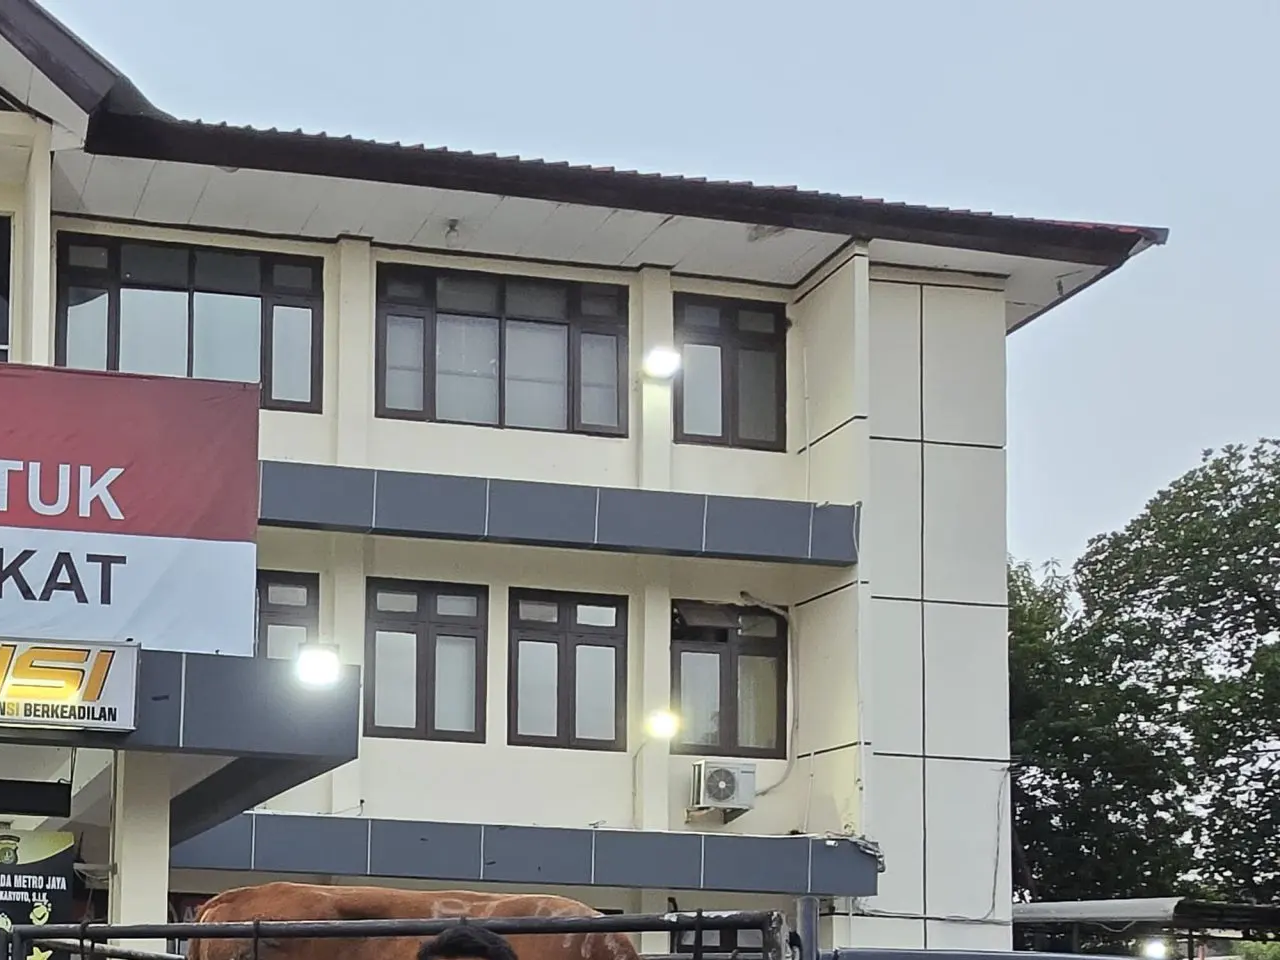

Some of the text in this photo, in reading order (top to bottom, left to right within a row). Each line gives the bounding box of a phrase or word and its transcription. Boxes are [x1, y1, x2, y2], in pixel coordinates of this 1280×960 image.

[23, 703, 118, 722] BERKEADILAN
[14, 874, 44, 889] METRO
[45, 876, 67, 890] JAYA
